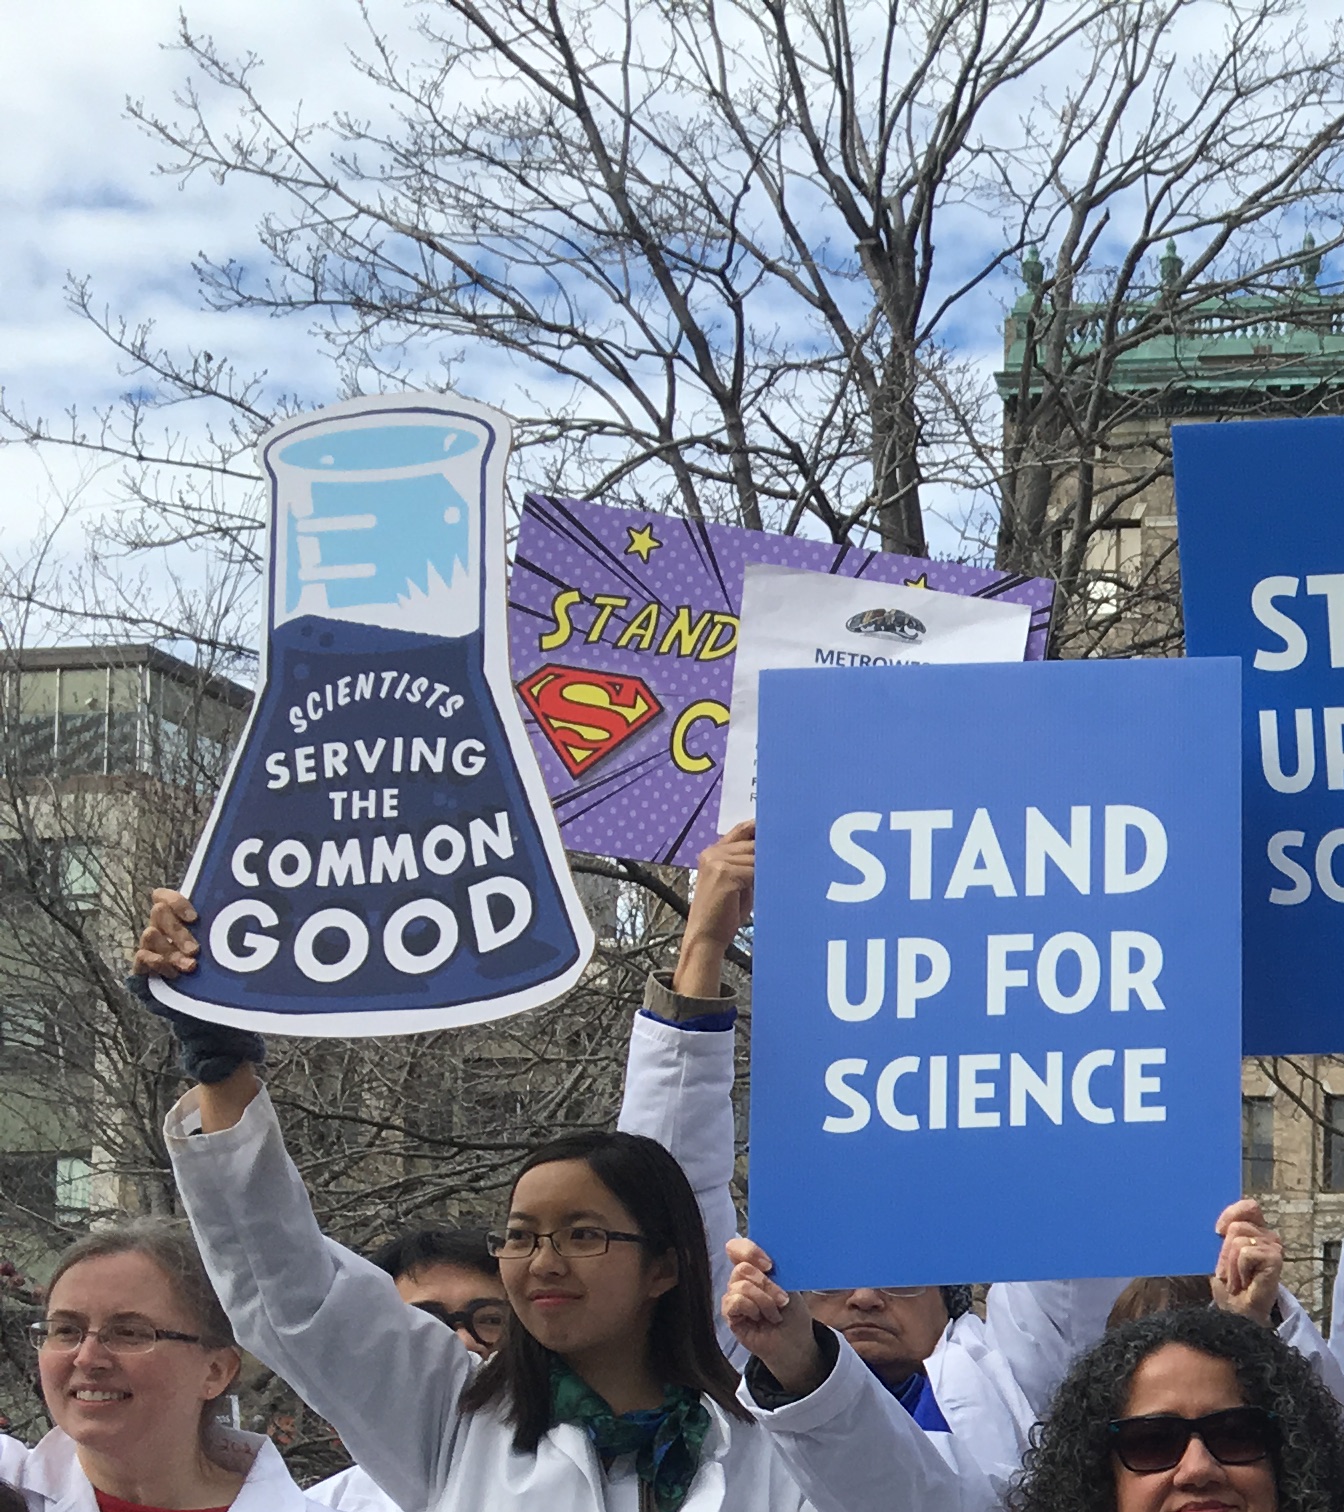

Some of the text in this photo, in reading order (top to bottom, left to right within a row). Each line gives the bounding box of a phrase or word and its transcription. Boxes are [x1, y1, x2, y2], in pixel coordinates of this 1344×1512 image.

[539, 588, 741, 662] STAND
[289, 671, 464, 733] SCIENTISTS
[265, 736, 487, 790] SERVING
[329, 789, 400, 821] THE
[231, 811, 518, 889] COMMON
[826, 804, 1168, 903] STAND
[210, 876, 533, 982] GOOD
[826, 930, 1167, 1023] UP FOR
[822, 1047, 1168, 1134] SCIENCE
